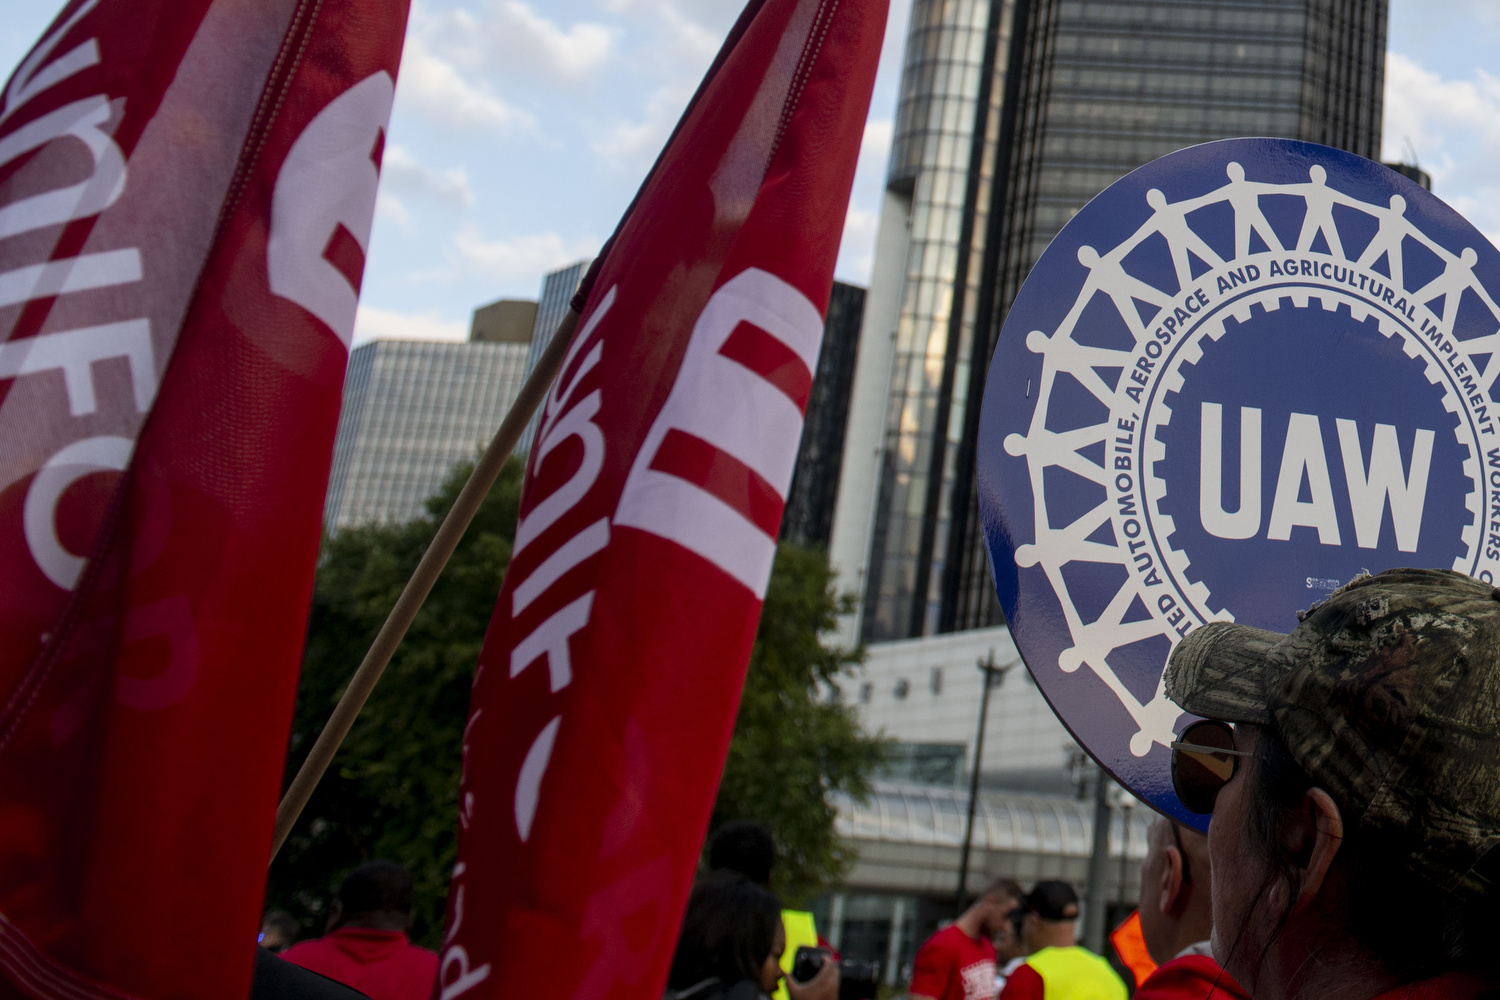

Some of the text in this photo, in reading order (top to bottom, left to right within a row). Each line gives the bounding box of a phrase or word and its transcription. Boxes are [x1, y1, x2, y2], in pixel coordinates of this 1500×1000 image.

[1215, 265, 1261, 295] AND
[1269, 259, 1416, 323] AGRICULTURAL
[1125, 288, 1209, 405] AEROSPACE
[1420, 317, 1495, 436] IMPLEMENT
[1113, 410, 1162, 587] AUTOMOBILE,
[1198, 401, 1435, 554] UAW
